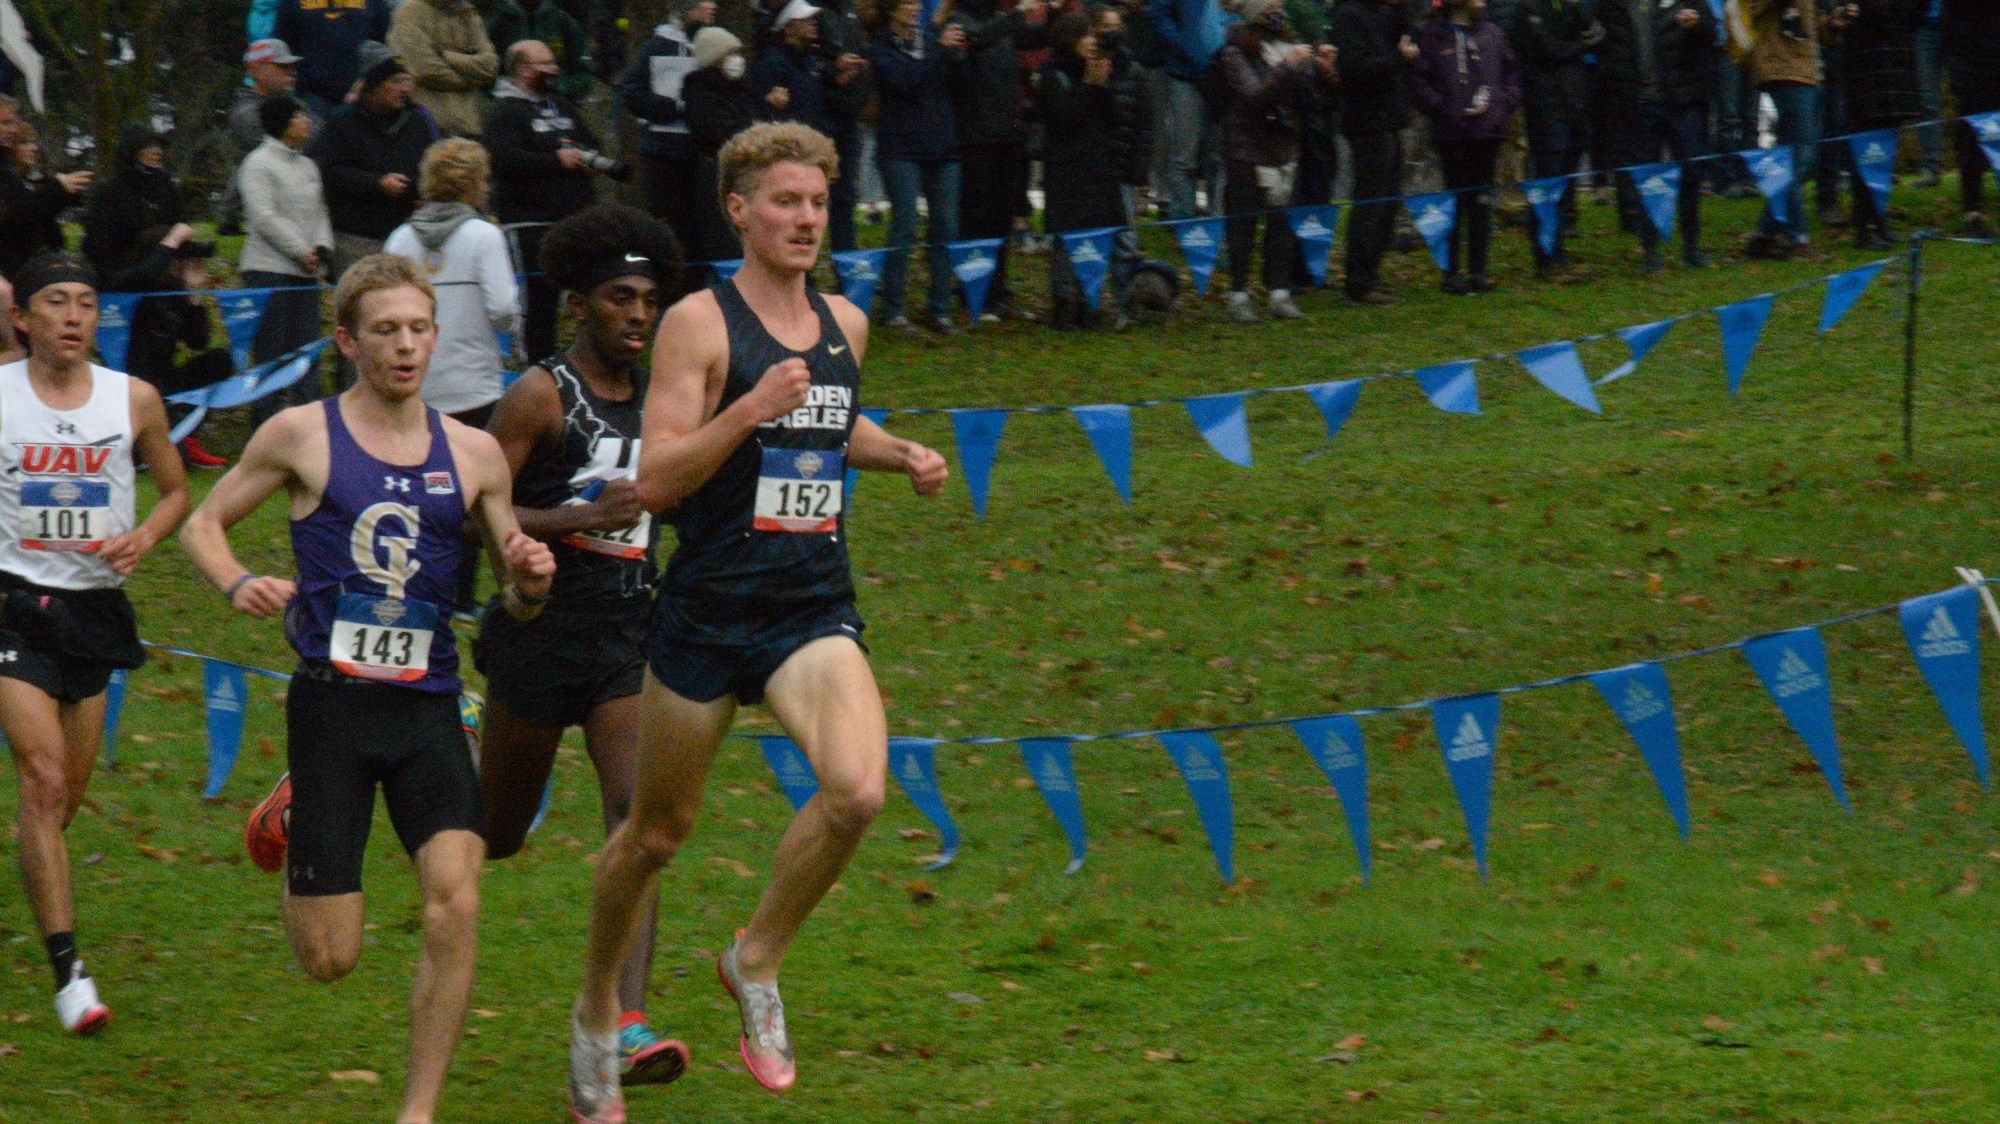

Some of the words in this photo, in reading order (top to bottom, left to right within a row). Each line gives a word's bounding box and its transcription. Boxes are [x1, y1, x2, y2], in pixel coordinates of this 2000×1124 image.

[803, 384, 852, 409] DEN
[21, 444, 114, 476] UAV
[775, 481, 832, 519] 152
[37, 508, 92, 539] 101
[350, 626, 415, 667] 143
